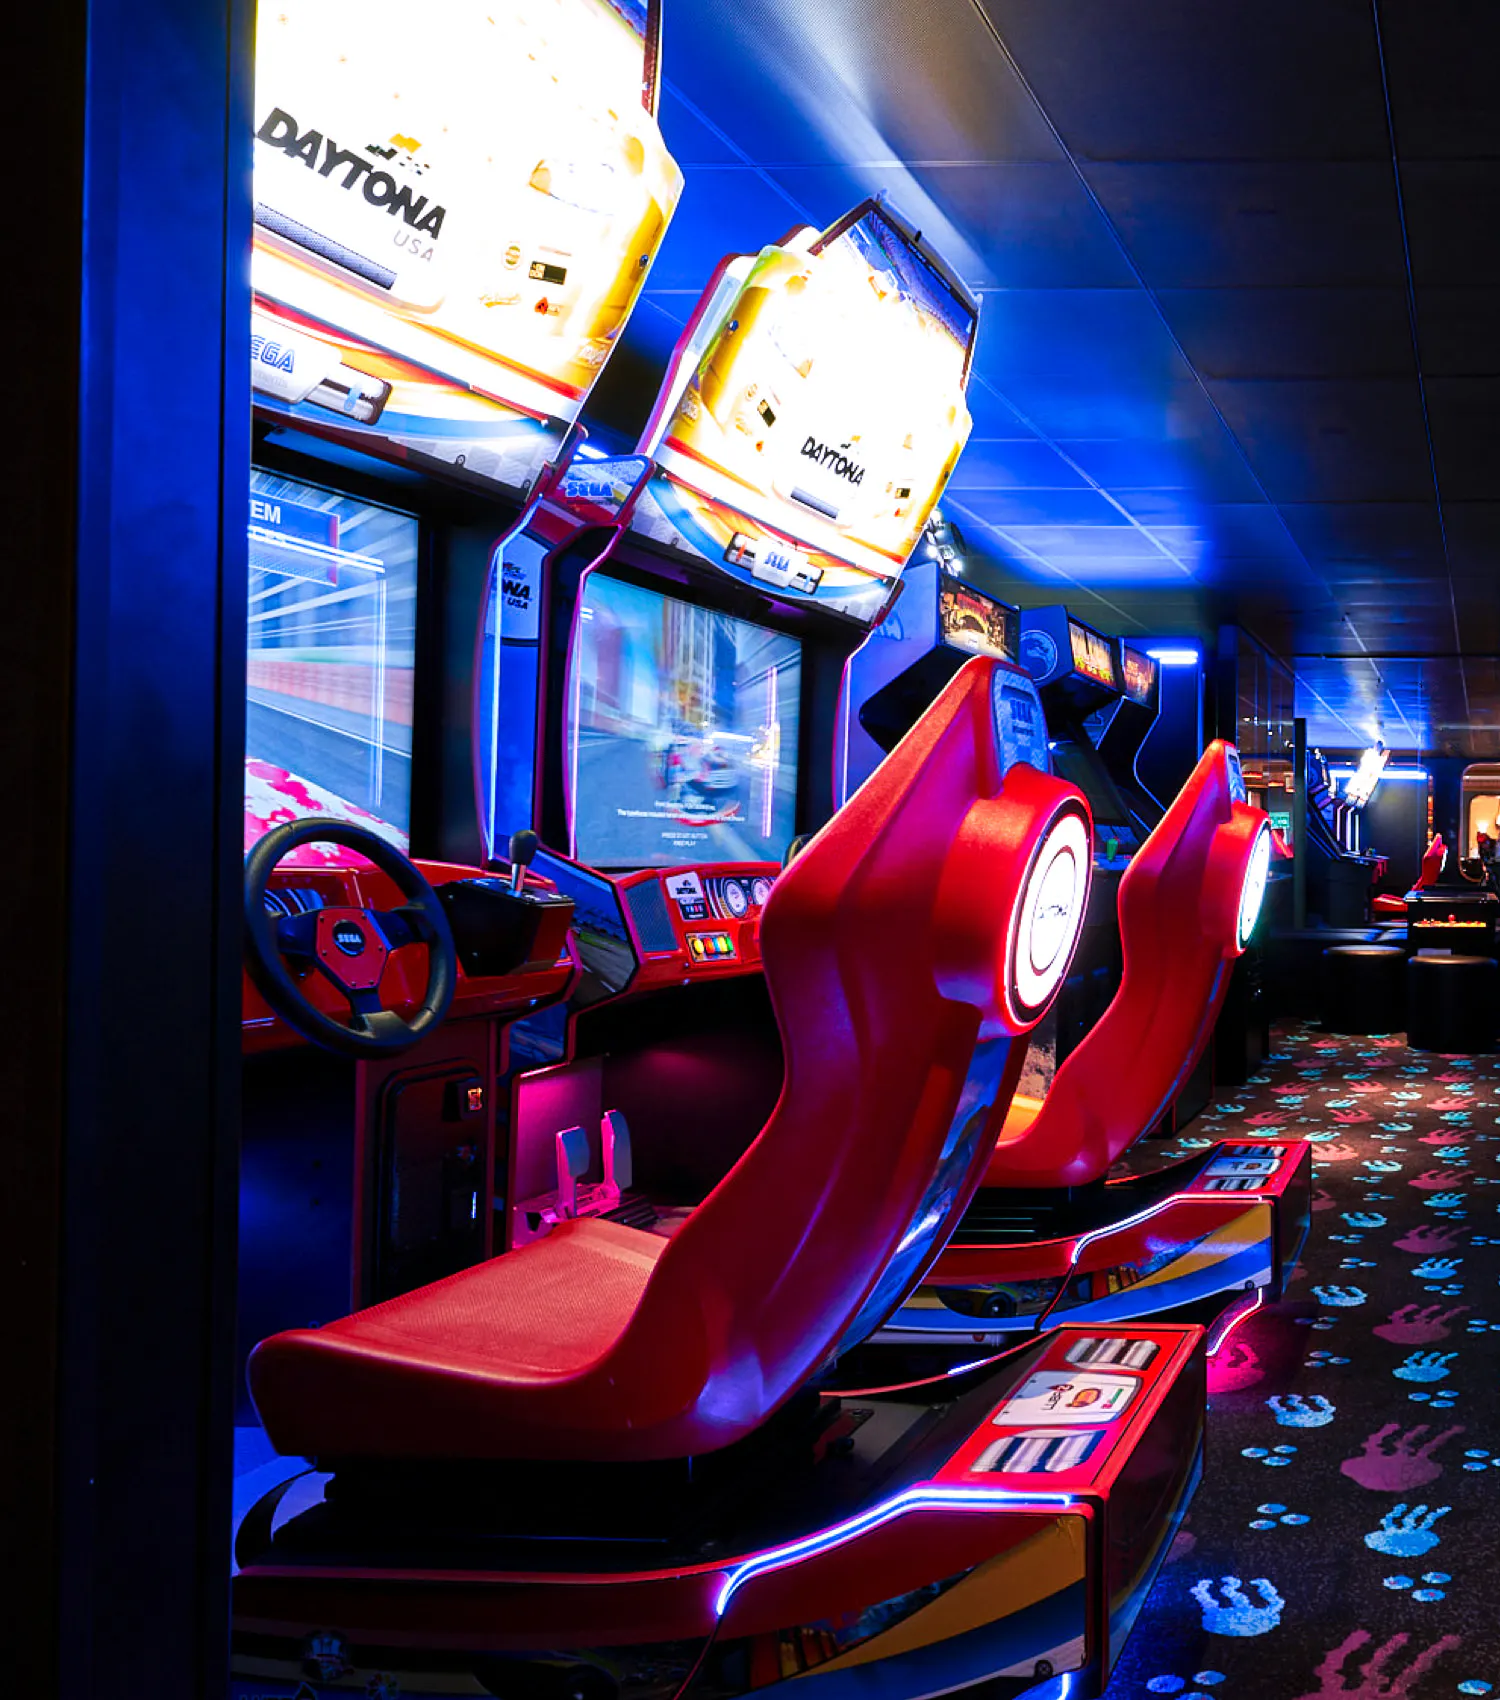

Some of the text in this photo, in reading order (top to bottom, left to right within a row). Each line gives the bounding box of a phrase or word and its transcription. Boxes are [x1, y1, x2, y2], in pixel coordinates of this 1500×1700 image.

[256, 107, 446, 240] DAYTONA
[393, 230, 434, 263] USA
[800, 436, 866, 487] DAYTONA
[566, 481, 613, 497] SEGA
[764, 551, 790, 572] SEGA
